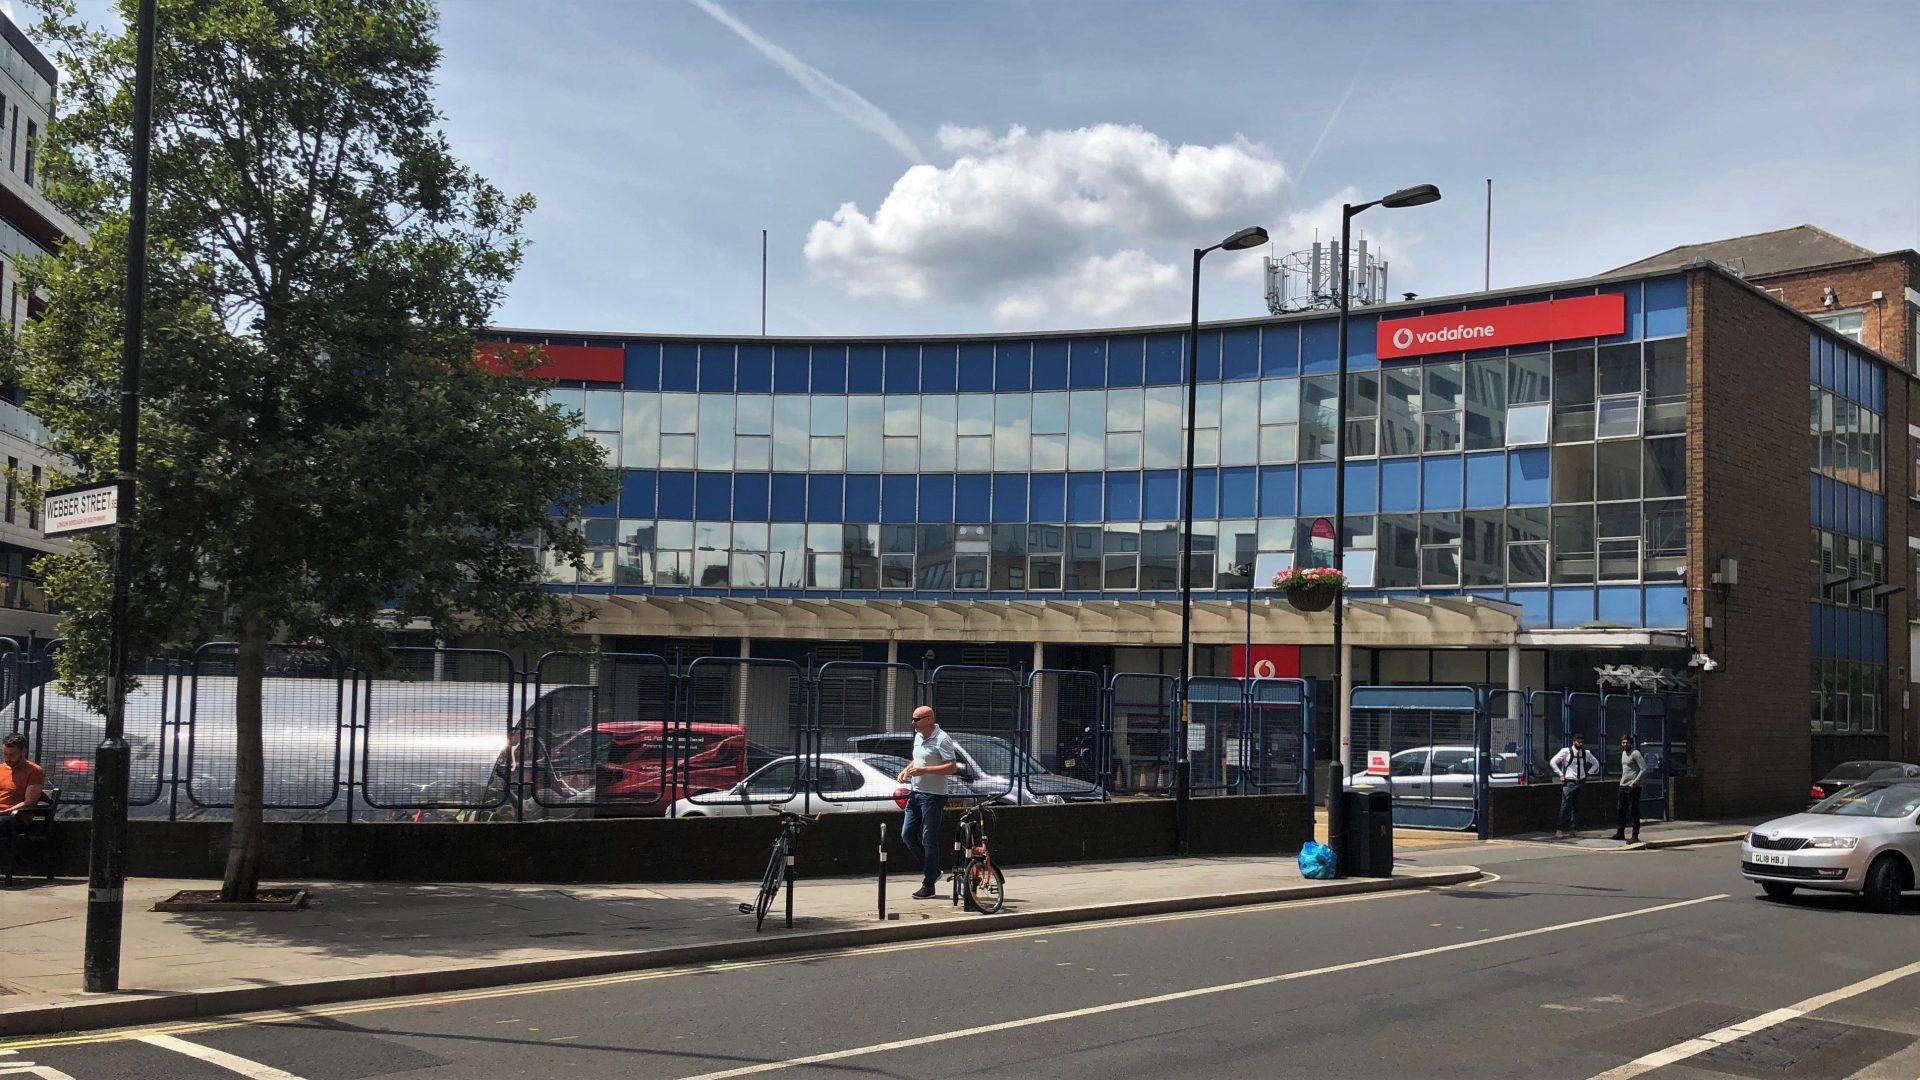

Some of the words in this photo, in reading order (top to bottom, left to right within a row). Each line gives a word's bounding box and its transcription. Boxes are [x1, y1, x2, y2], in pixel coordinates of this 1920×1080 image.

[1416, 324, 1494, 344] vodafone
[47, 497, 79, 519] WEBBER
[81, 491, 112, 513] STREET
[1755, 854, 1769, 863] GL18
[1771, 856, 1785, 864] HBJ
